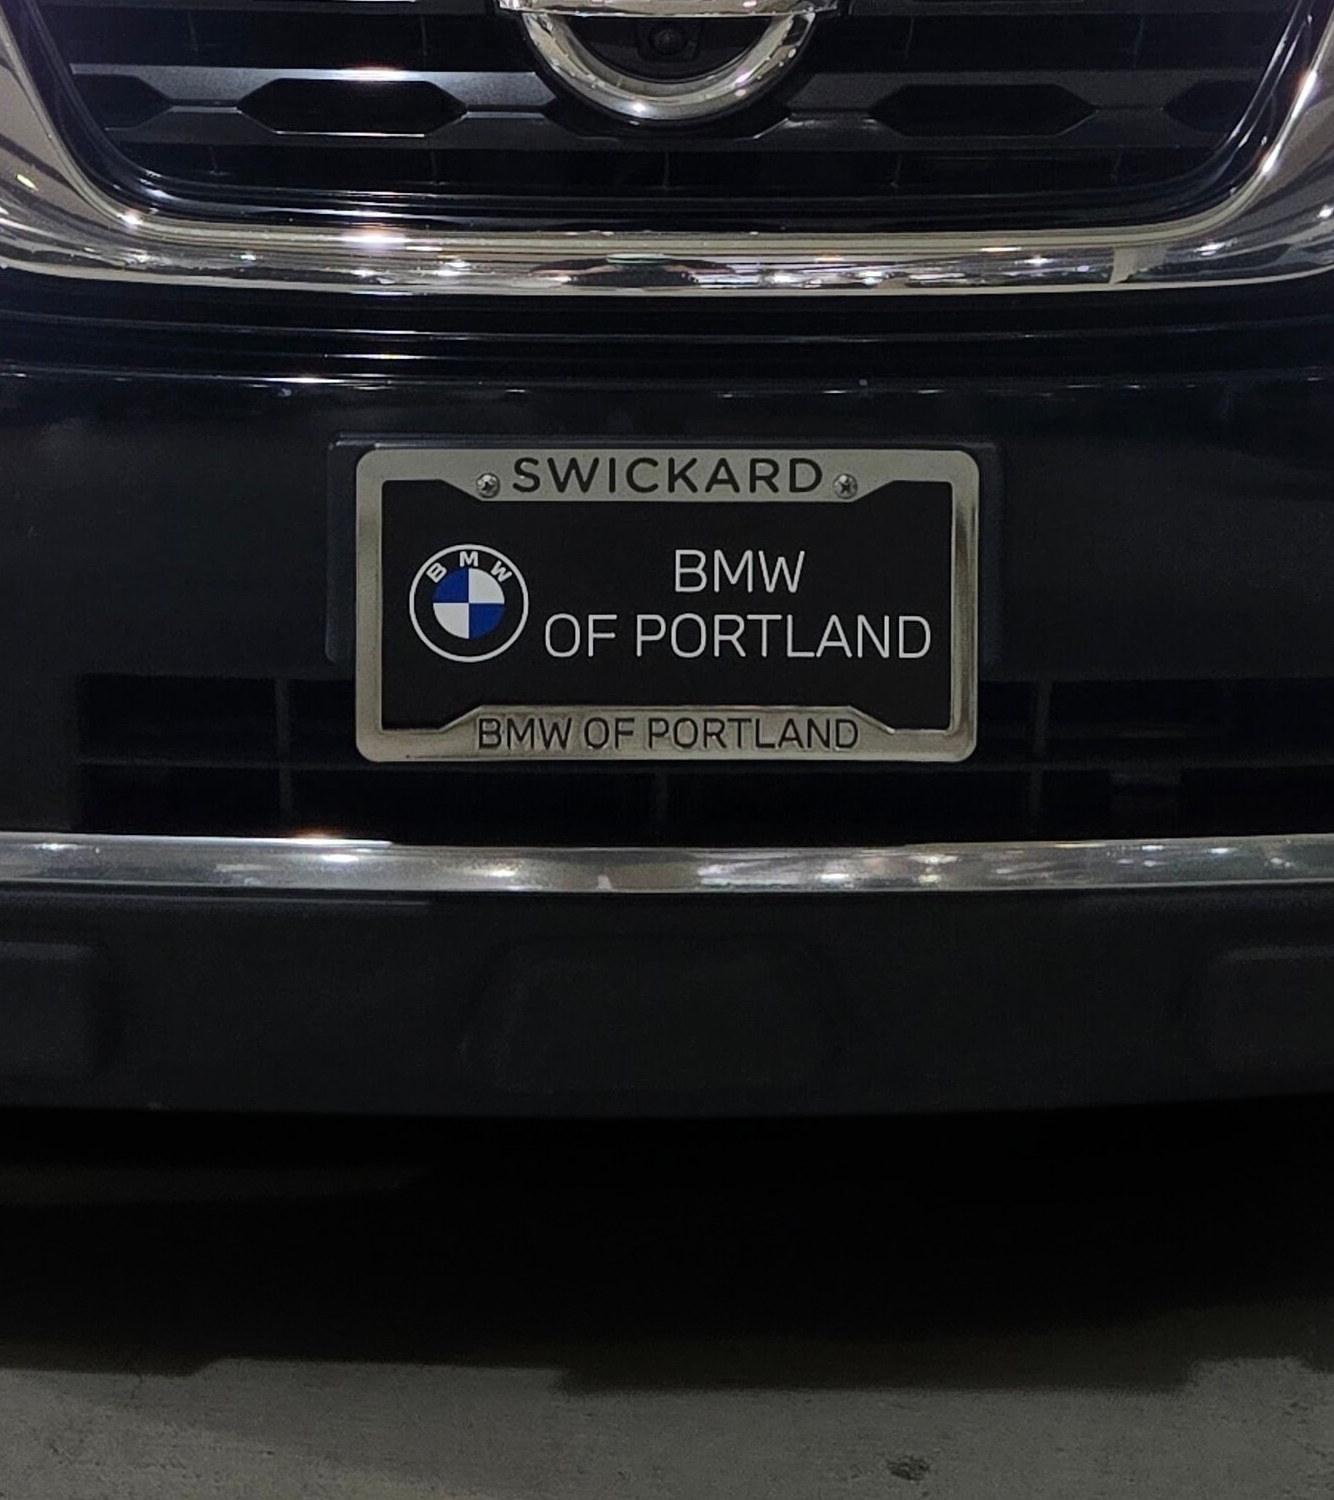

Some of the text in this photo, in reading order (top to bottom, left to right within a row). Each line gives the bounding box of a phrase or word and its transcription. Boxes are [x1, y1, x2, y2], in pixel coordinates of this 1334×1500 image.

[512, 456, 823, 494] SWICKARD
[426, 550, 513, 584] BMW
[673, 548, 805, 594] BMW
[544, 613, 932, 659] OF PORTLAND
[478, 717, 859, 750] BMW OF PORTLAND
